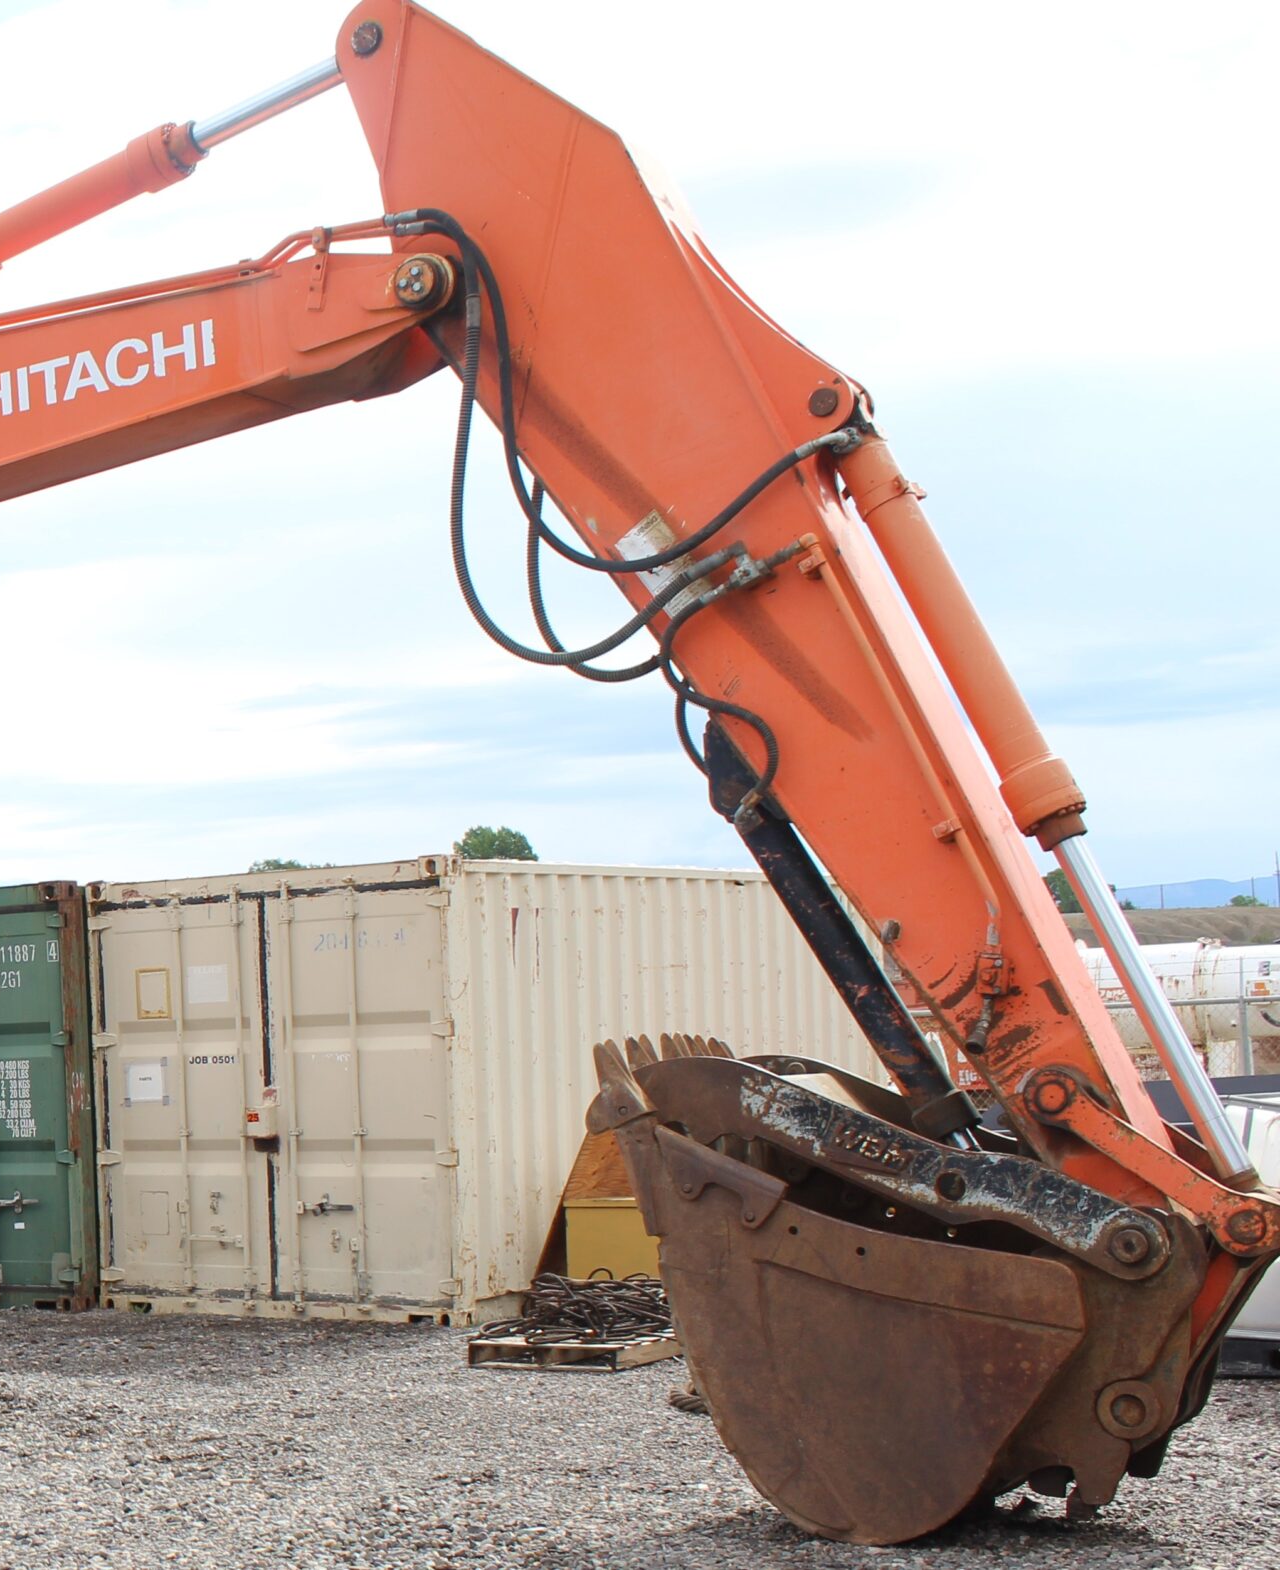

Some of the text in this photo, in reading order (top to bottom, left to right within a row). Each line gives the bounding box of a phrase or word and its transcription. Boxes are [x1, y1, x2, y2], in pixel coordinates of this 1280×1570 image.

[17, 1060, 30, 1070] KGS
[189, 1055, 235, 1065] JOB 0501
[18, 1069, 29, 1079] LBS
[18, 1080, 31, 1089] KGS
[19, 1089, 30, 1098] LBS
[19, 1099, 31, 1109] KGS
[19, 1109, 31, 1119] LBS
[247, 1113, 259, 1122] 25
